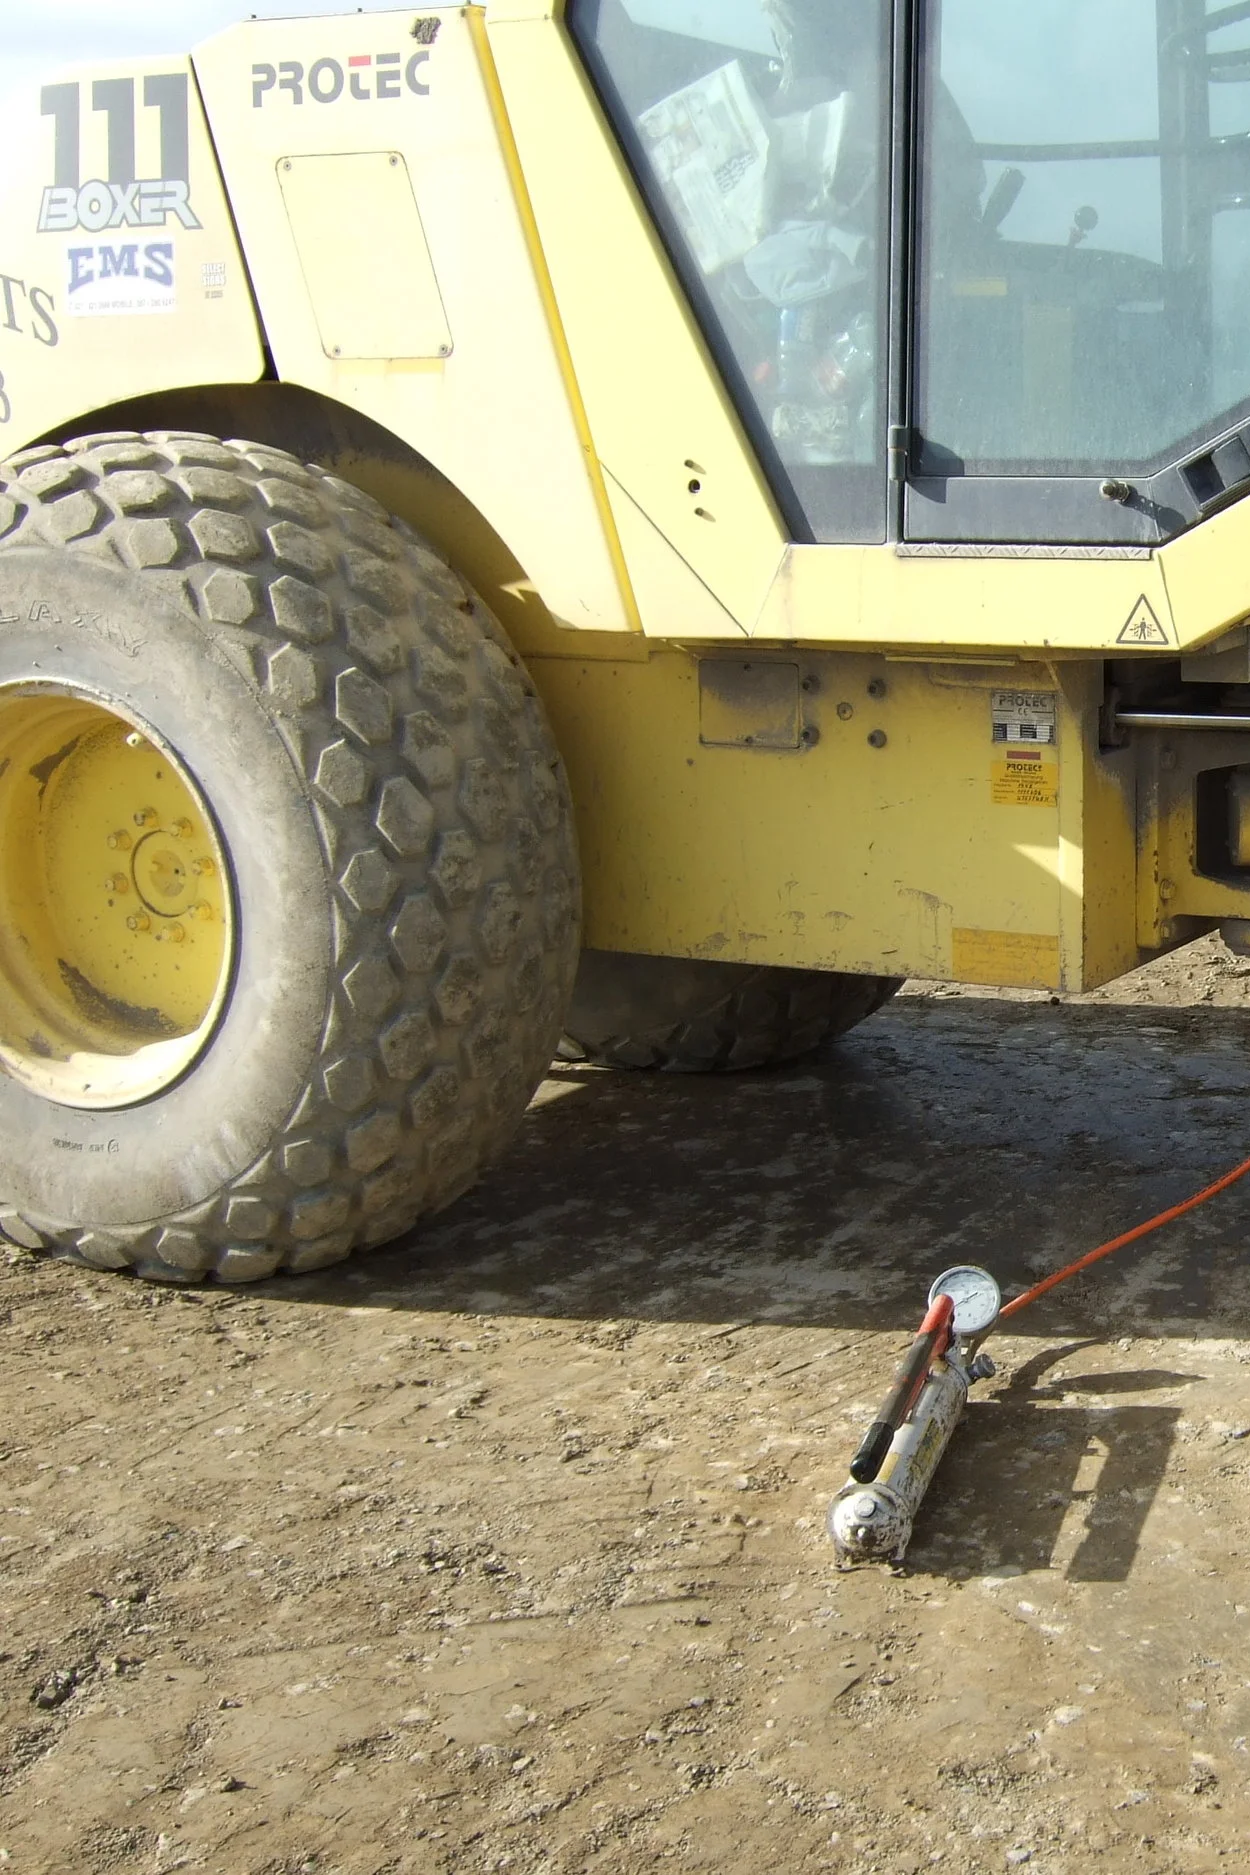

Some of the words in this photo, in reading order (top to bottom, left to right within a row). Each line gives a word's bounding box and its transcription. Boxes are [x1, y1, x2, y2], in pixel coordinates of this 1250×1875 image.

[252, 50, 430, 108] PROTEC
[40, 72, 189, 187] 111
[36, 179, 203, 232] BOXER
[67, 241, 174, 296] EMS
[999, 695, 1048, 708] PROTEC
